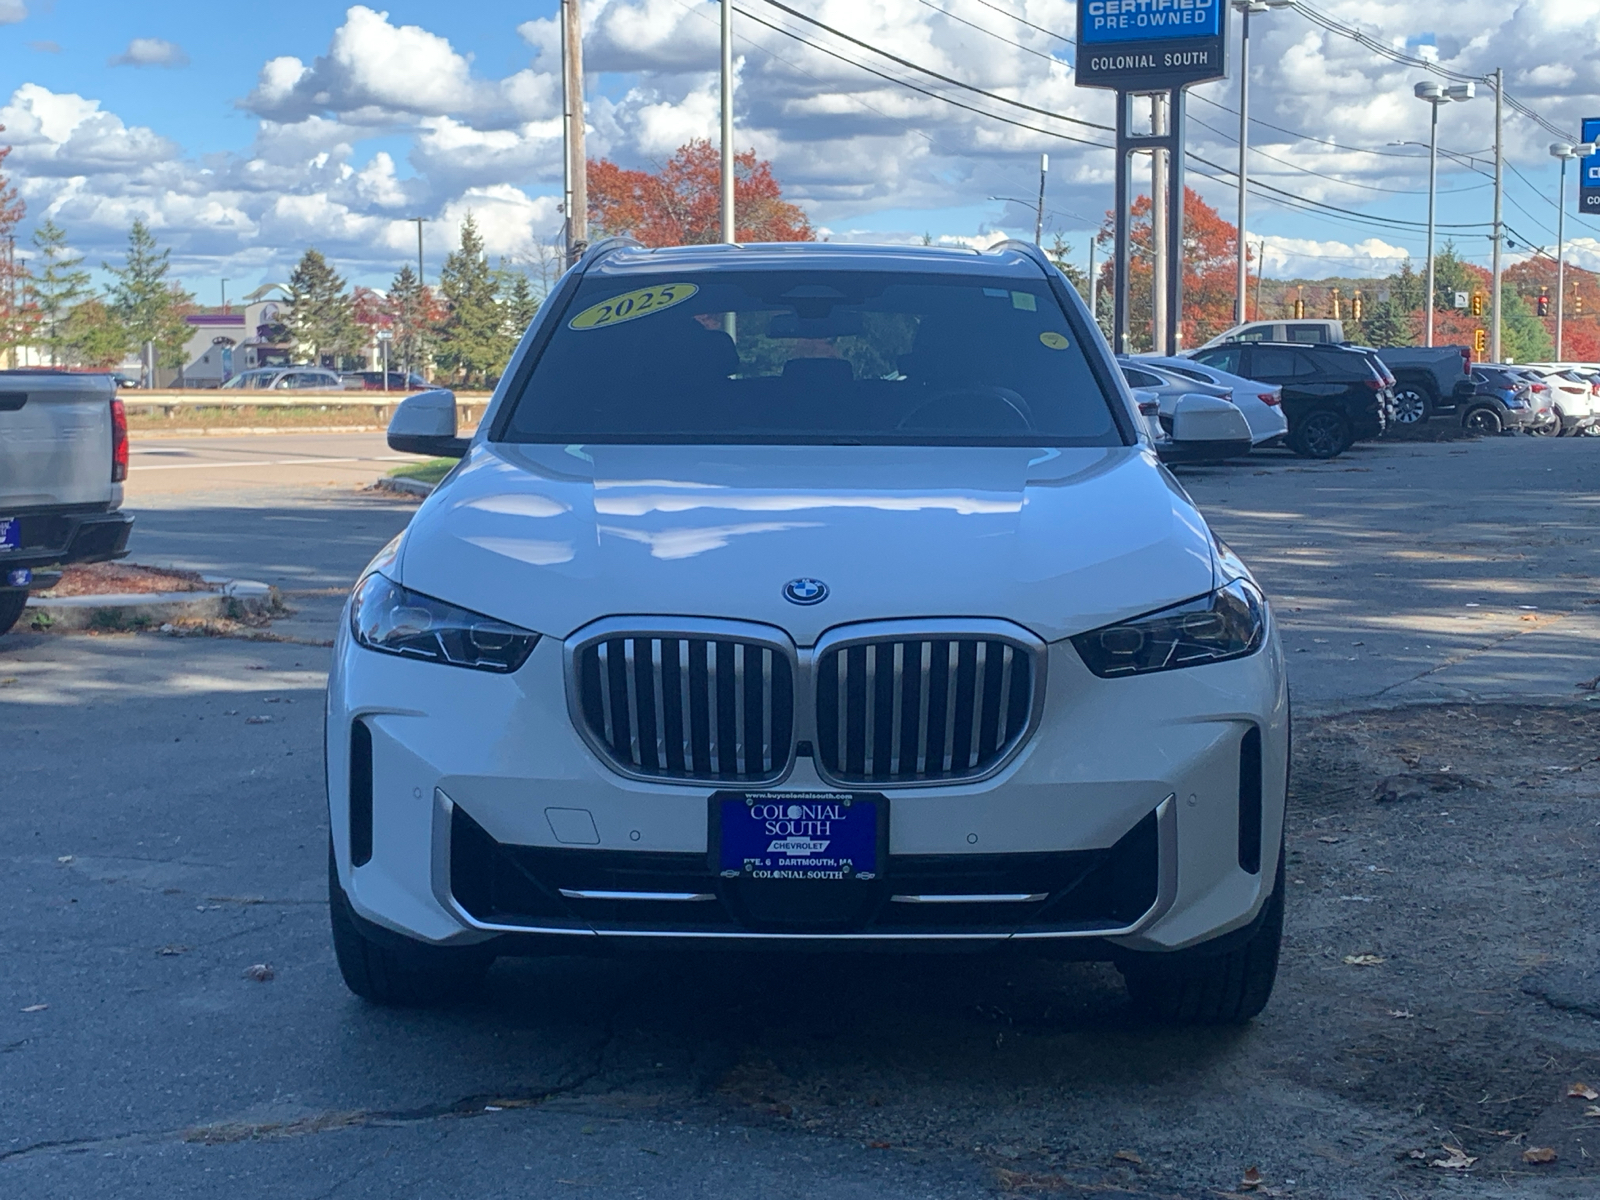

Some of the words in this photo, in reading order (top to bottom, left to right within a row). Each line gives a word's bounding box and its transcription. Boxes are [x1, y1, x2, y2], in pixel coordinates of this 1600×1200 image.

[1088, 0, 1212, 15] CERTIFIED
[1094, 10, 1206, 30] PRE-OWNED
[1091, 54, 1156, 70] COLONIAL
[1164, 52, 1208, 66] SOUTH
[593, 286, 676, 326] 2025
[745, 792, 853, 800] www.buycolonialsouth.com
[750, 804, 847, 820] COLONIAL
[765, 821, 831, 836] SOUTH
[773, 842, 823, 850] CHEVROLET
[765, 858, 772, 866] 6
[778, 858, 837, 867] DARTMOUTH,
[839, 858, 853, 866] MA
[752, 870, 806, 879] COLONIAL
[807, 870, 844, 880] SOUTH
